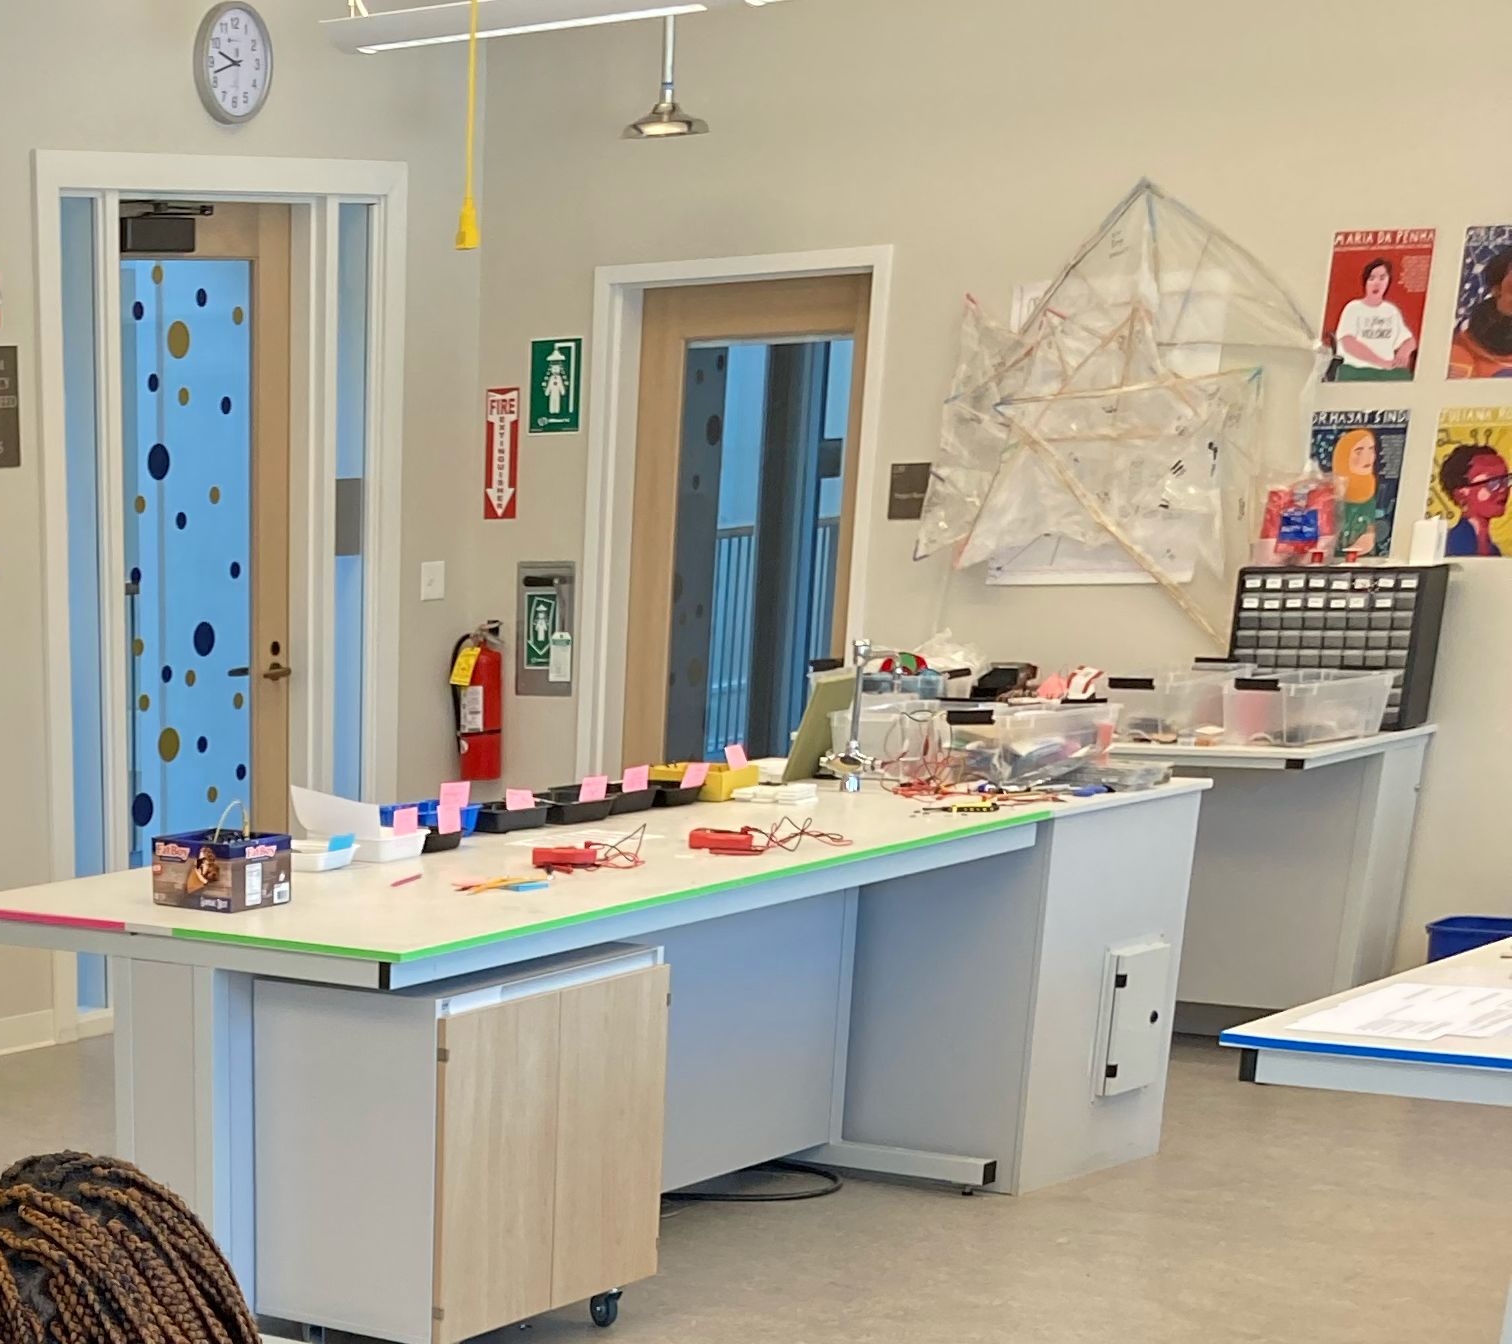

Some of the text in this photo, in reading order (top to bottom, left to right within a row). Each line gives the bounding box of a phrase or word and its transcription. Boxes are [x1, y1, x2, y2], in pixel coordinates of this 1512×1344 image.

[1335, 229, 1434, 246] MARIA DA PENHA
[489, 398, 515, 415] FIRE
